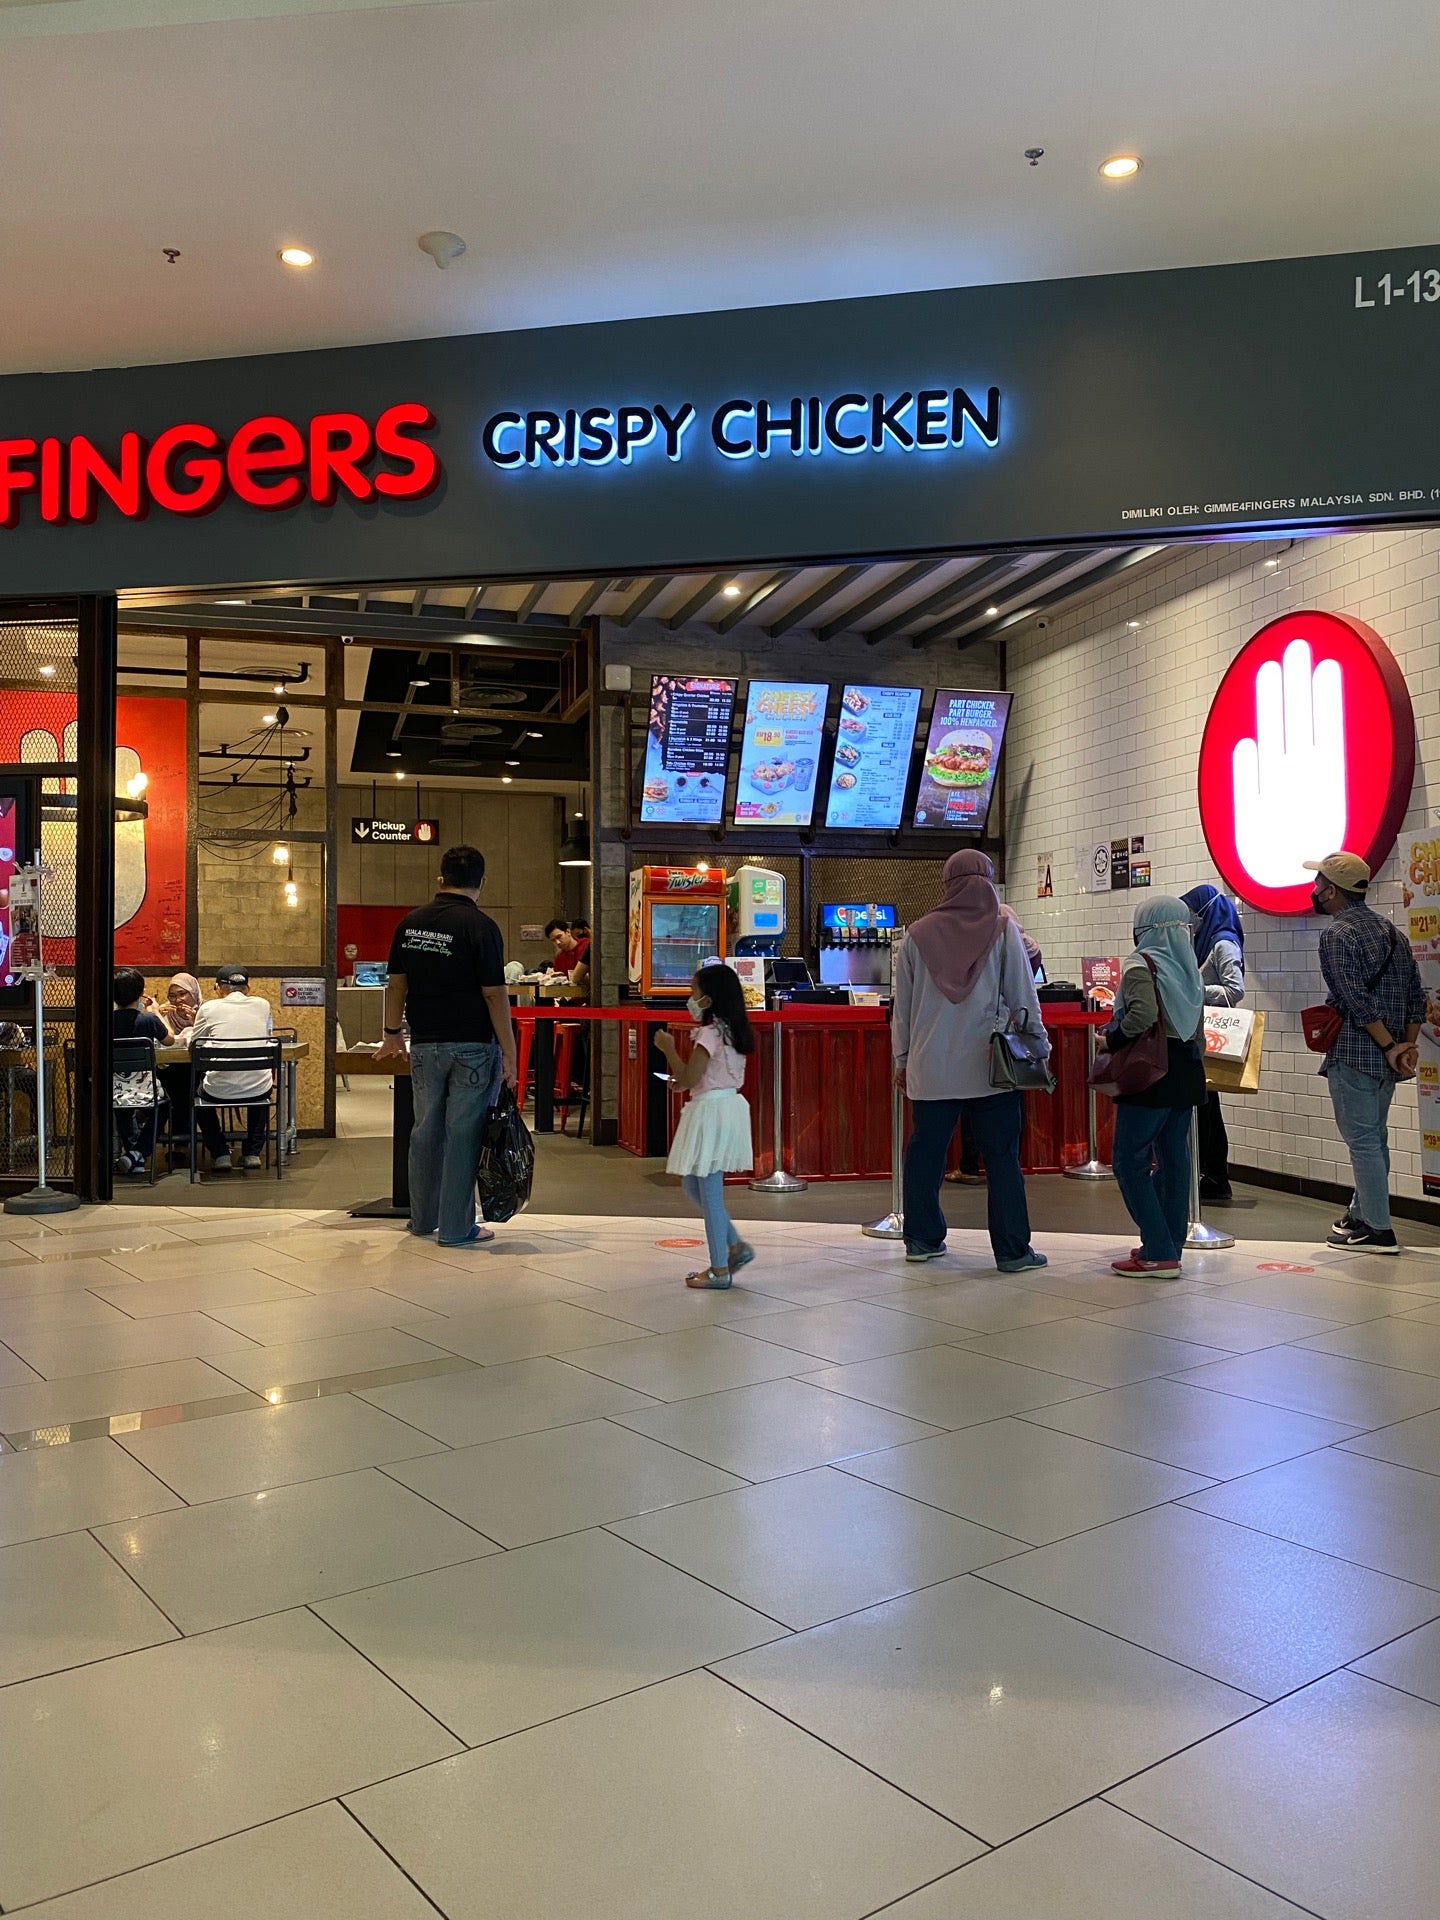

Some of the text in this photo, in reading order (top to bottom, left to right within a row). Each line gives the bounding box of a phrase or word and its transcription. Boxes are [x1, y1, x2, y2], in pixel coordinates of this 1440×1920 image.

[482, 387, 1001, 469] CRISPY CHICKEN
[1121, 507, 1163, 519] DIMILIKI
[1167, 505, 1199, 516] OLEH:
[1204, 498, 1296, 513] GIMME4FINGERS
[1300, 494, 1363, 507] MALAYSIA
[1368, 491, 1394, 502] SDN.
[1400, 490, 1426, 501] BHD.
[949, 699, 966, 708] PART
[948, 708, 965, 717] PART
[371, 821, 406, 831] Pickup
[371, 831, 412, 841] Counter
